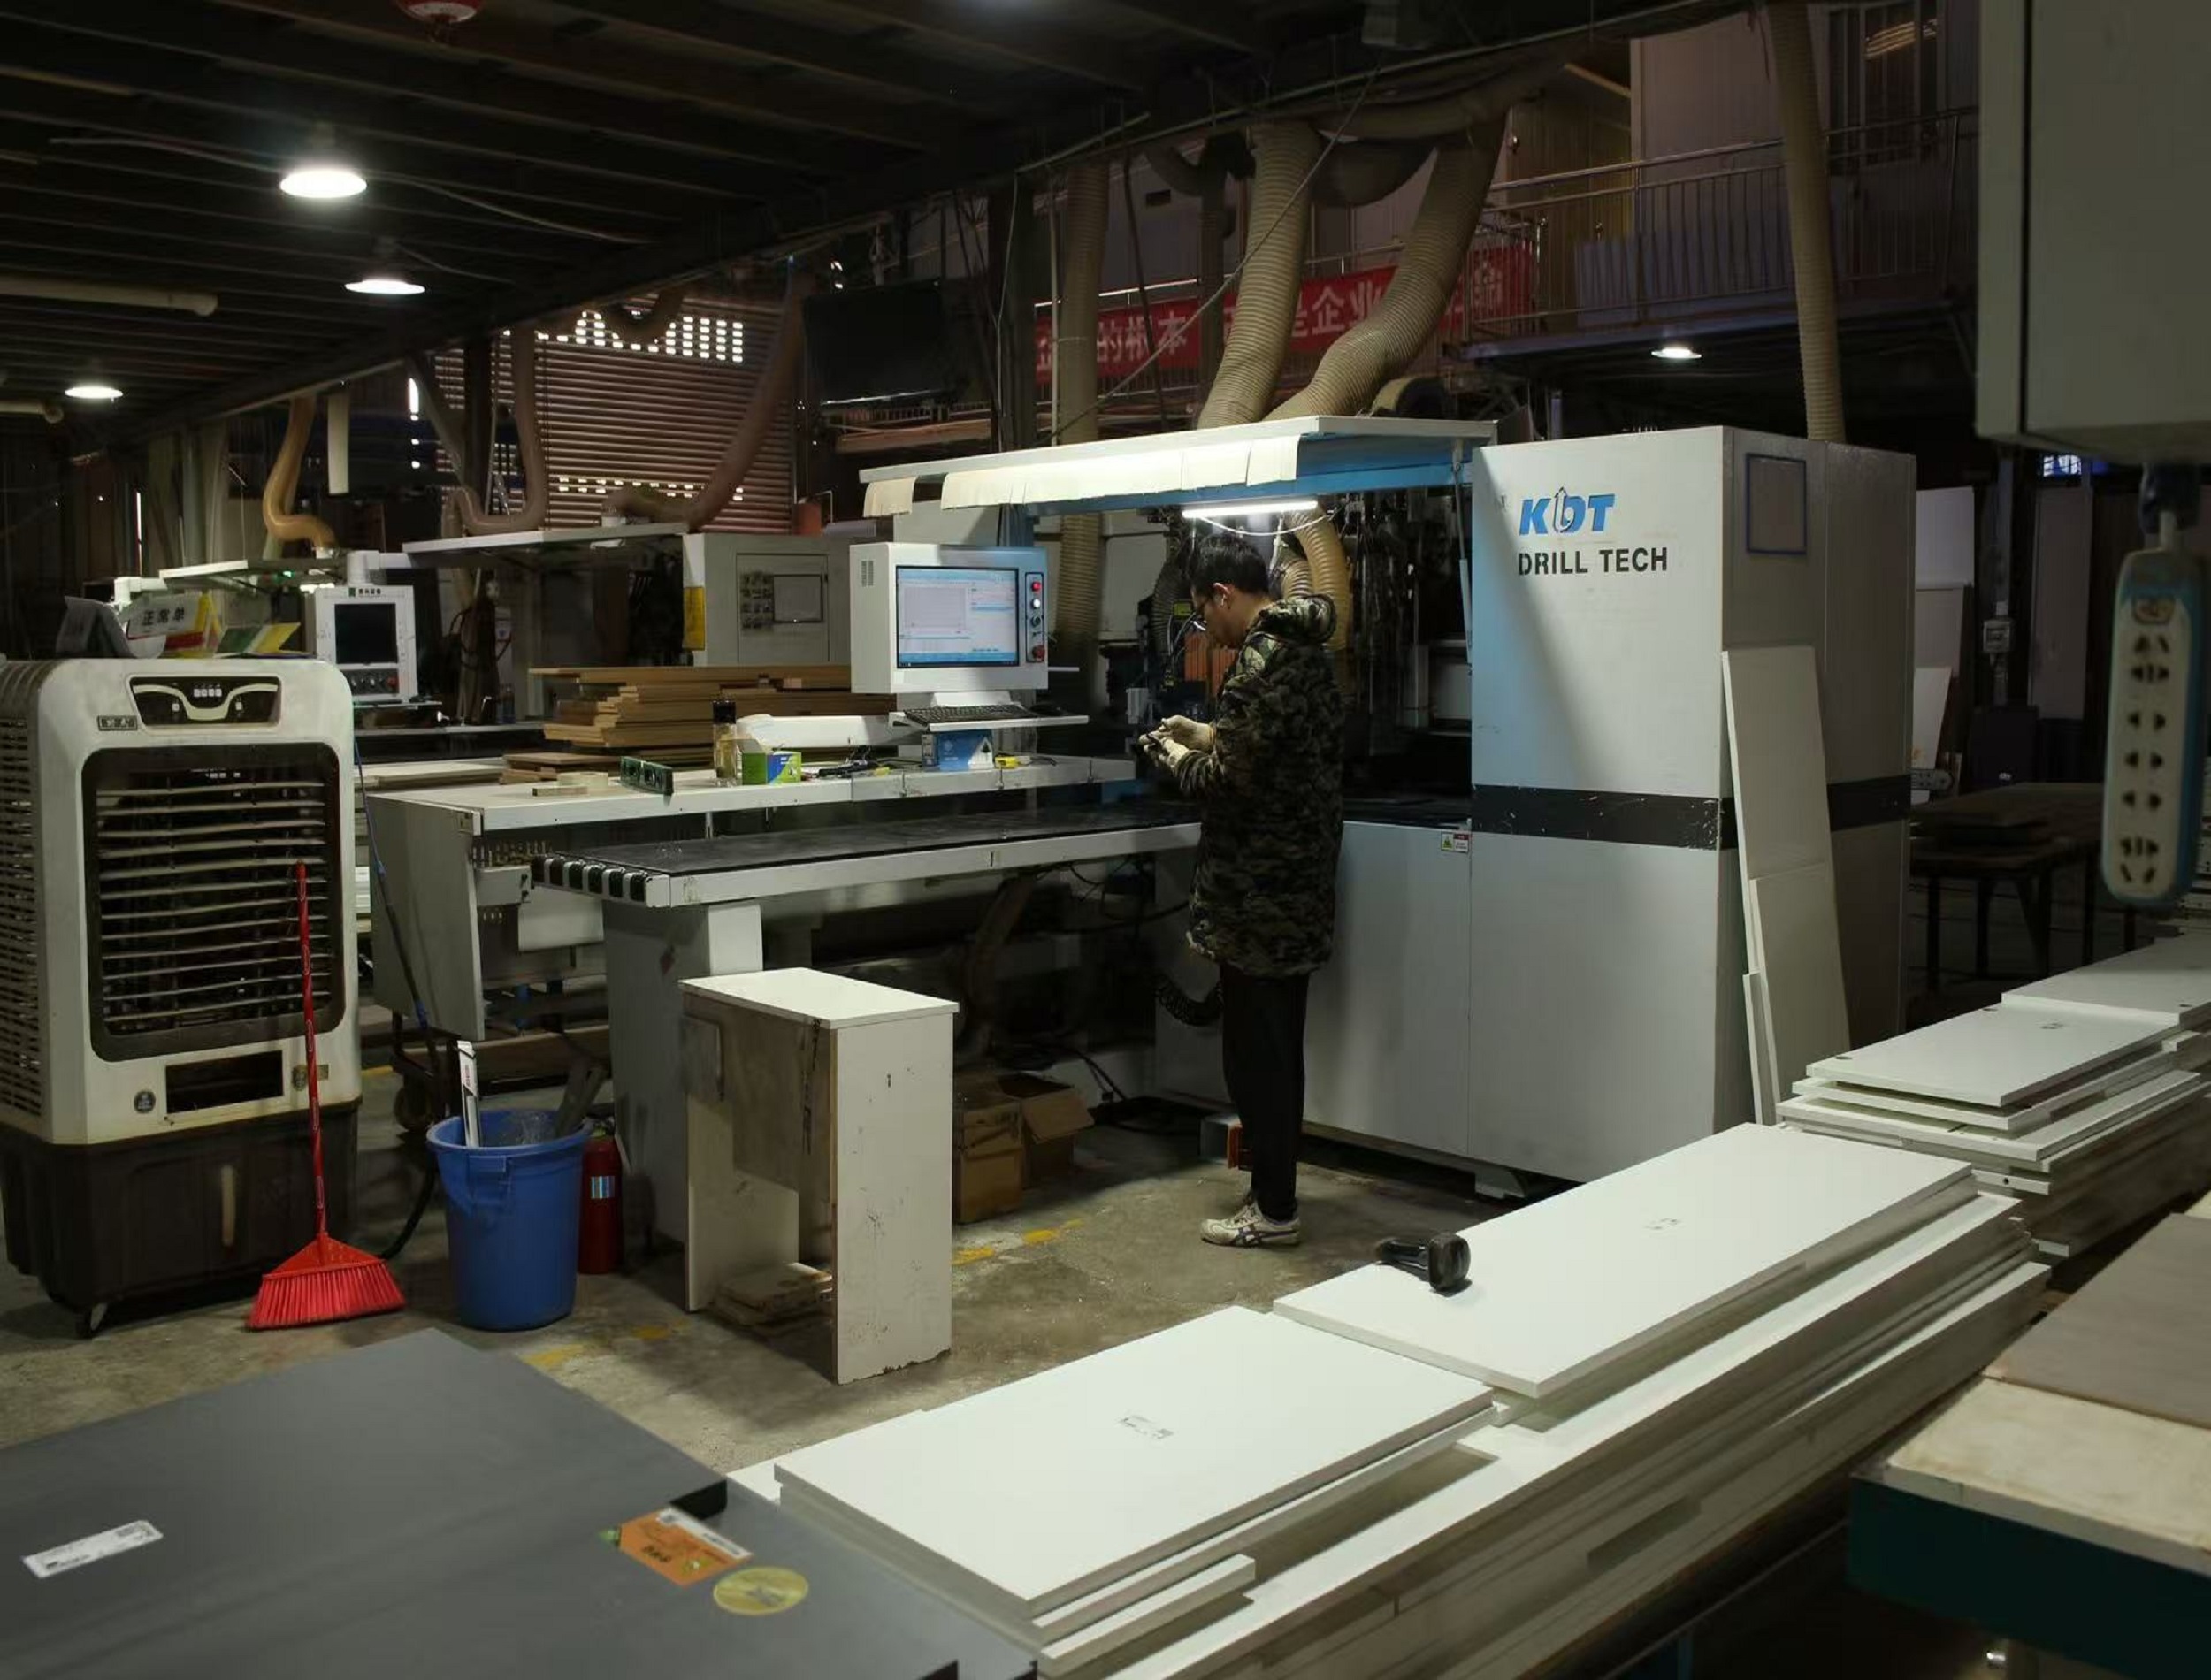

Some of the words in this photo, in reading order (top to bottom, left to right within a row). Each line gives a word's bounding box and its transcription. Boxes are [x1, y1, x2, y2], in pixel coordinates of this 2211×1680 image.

[1519, 487, 1616, 535] KDT
[1519, 549, 1589, 576] DRILL
[1600, 546, 1668, 573] TECH
